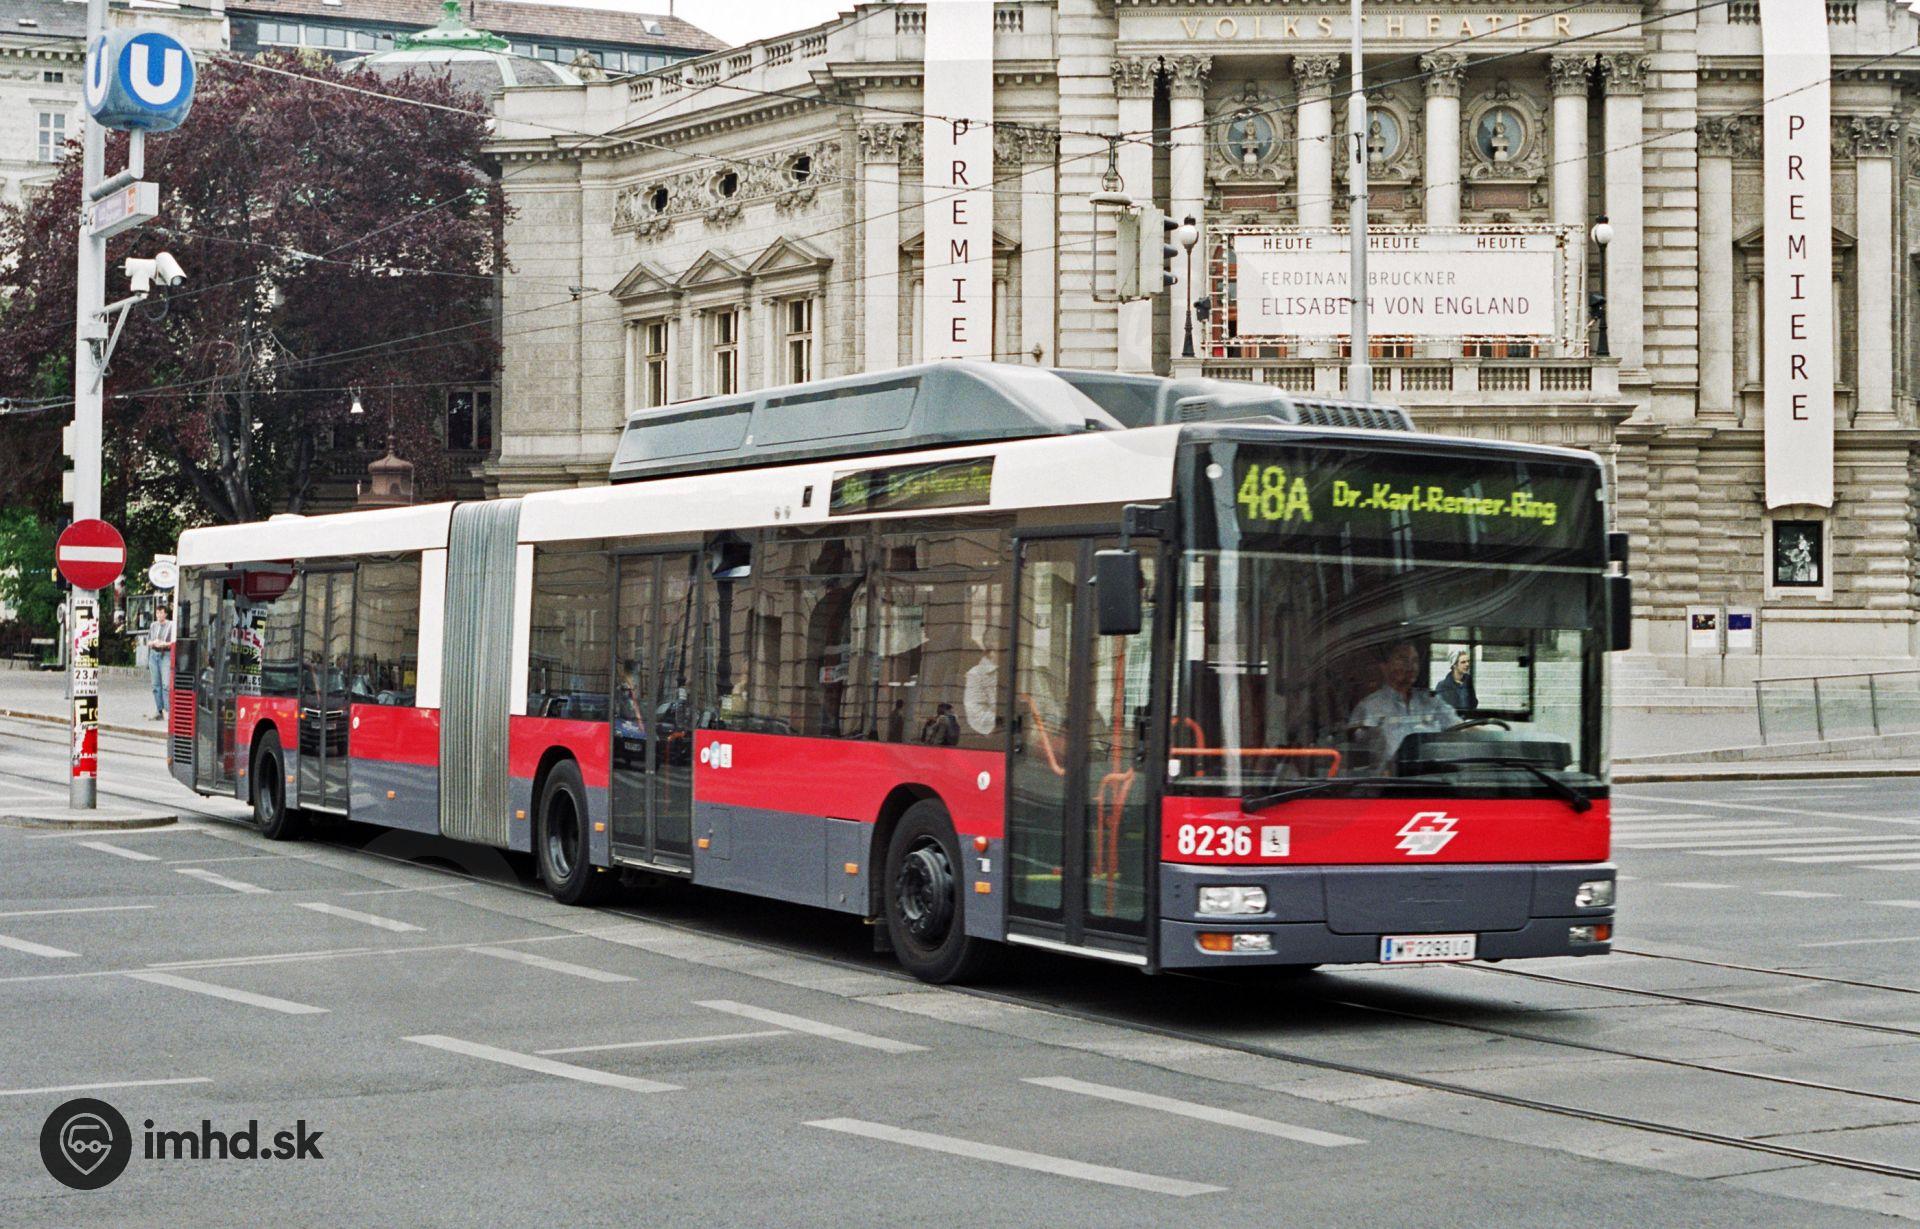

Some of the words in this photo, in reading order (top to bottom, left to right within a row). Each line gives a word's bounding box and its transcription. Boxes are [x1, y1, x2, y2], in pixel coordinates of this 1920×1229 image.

[86, 44, 109, 107] U
[130, 43, 182, 105] U
[1263, 238, 1313, 249] HEUTE
[1370, 237, 1420, 249] HEUTE
[1477, 237, 1527, 249] HEUTE
[1262, 272, 1347, 285] FERDINAN
[1368, 272, 1456, 285] BRUCKNER
[1788, 115, 1809, 420] PREMIERE
[1262, 297, 1374, 315] ELISABEH
[1385, 297, 1424, 315] VON
[1435, 297, 1529, 315] ENGLAND
[1237, 464, 1313, 522] 48A
[1333, 480, 1557, 526] Dr.-Karl-Renner-Ring
[1178, 824, 1252, 856] 8236
